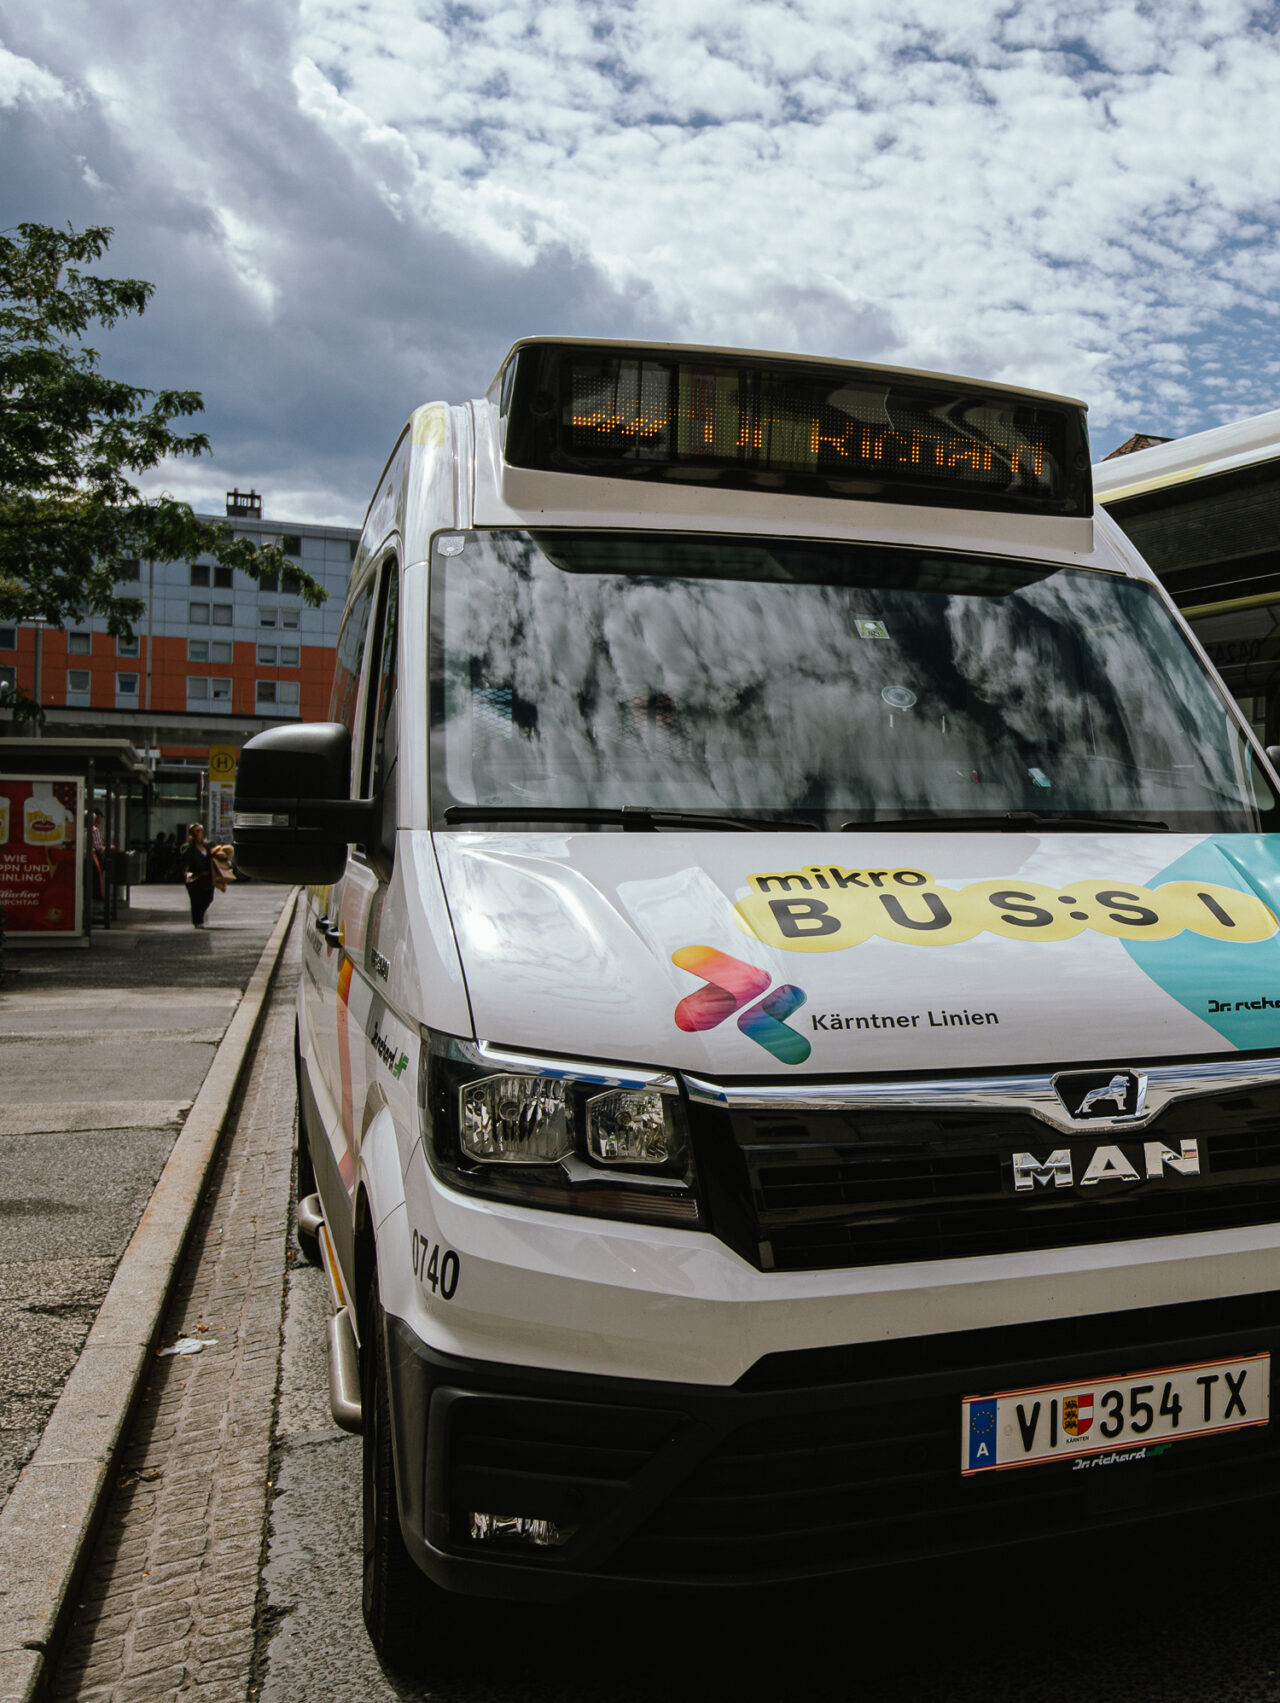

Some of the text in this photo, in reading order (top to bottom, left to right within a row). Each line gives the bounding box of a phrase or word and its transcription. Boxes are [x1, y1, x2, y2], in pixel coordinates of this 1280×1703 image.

[217, 756, 228, 769] H
[3, 854, 28, 863] WIE
[24, 864, 50, 873] UND
[755, 866, 928, 894] mikro
[767, 890, 1237, 938] BUS:SI
[811, 1009, 1000, 1032] Kärntner Linien
[1013, 1138, 1201, 1192] MAN
[412, 1227, 460, 1301] 0740
[1016, 1369, 1248, 1453] VI 354 TX
[976, 1442, 990, 1458] A
